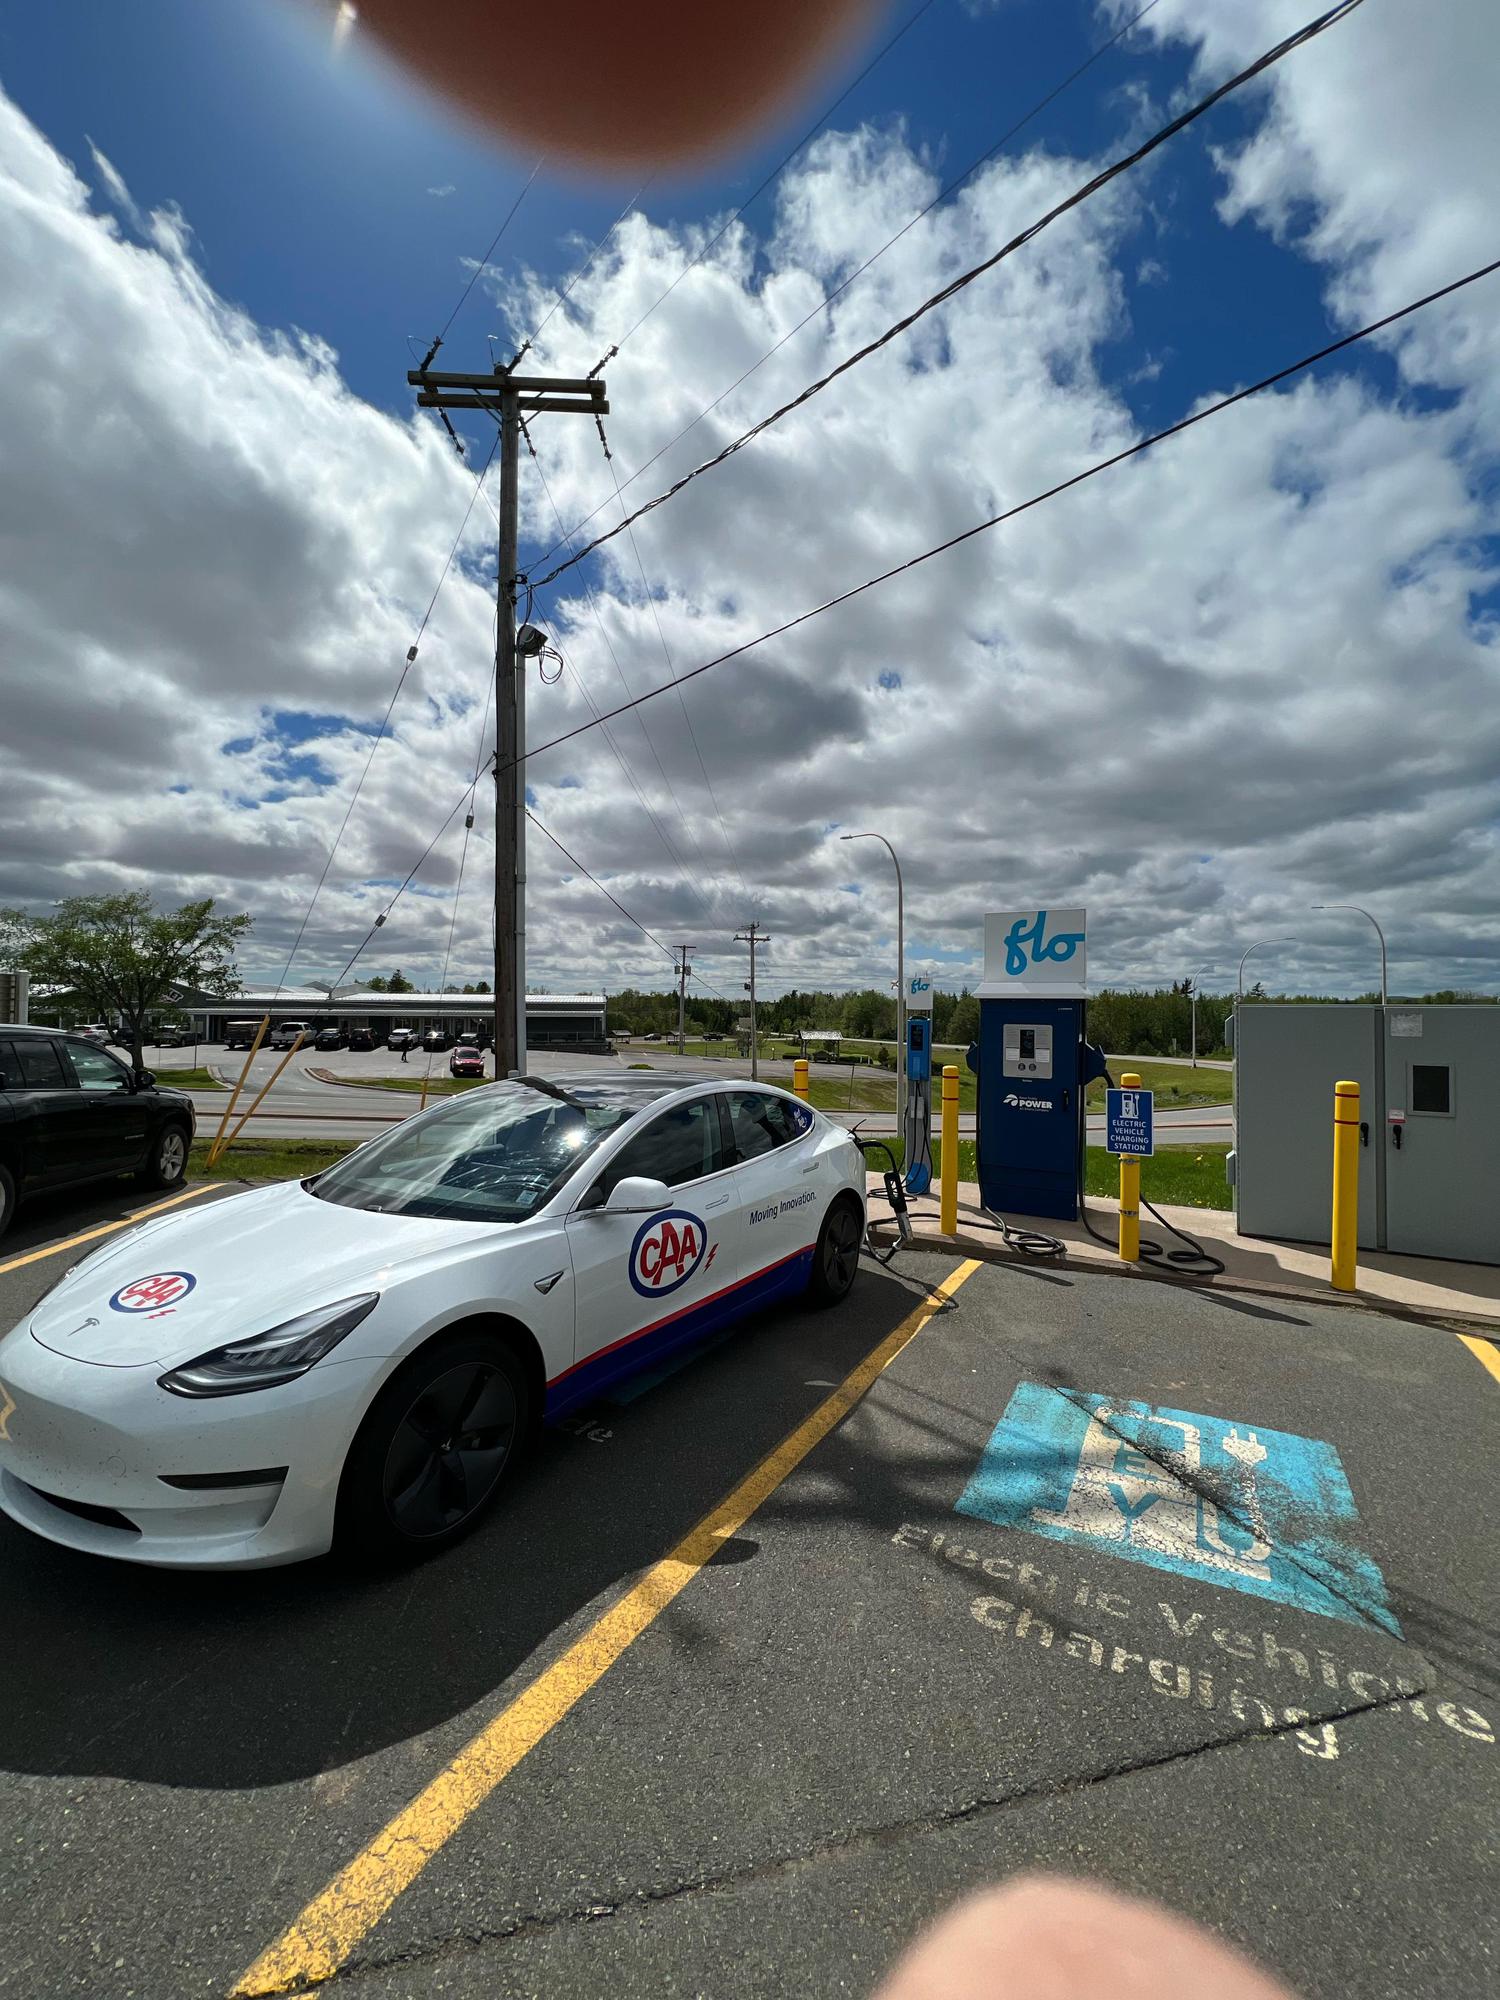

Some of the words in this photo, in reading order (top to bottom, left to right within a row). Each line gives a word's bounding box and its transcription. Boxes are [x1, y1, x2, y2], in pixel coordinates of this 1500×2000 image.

[1004, 911, 1085, 975] flo
[911, 978, 930, 993] flo
[1019, 1100, 1052, 1109] POWER
[1112, 1120, 1147, 1128] ELECTRIC
[1115, 1127, 1145, 1136] VEHICLE
[1110, 1135, 1149, 1144] CHARGING
[1114, 1143, 1146, 1151] STATION
[749, 1205, 778, 1225] Moving
[640, 1221, 697, 1286] CAA
[120, 1276, 184, 1307] CAA
[970, 1595, 1340, 1760] Charging
